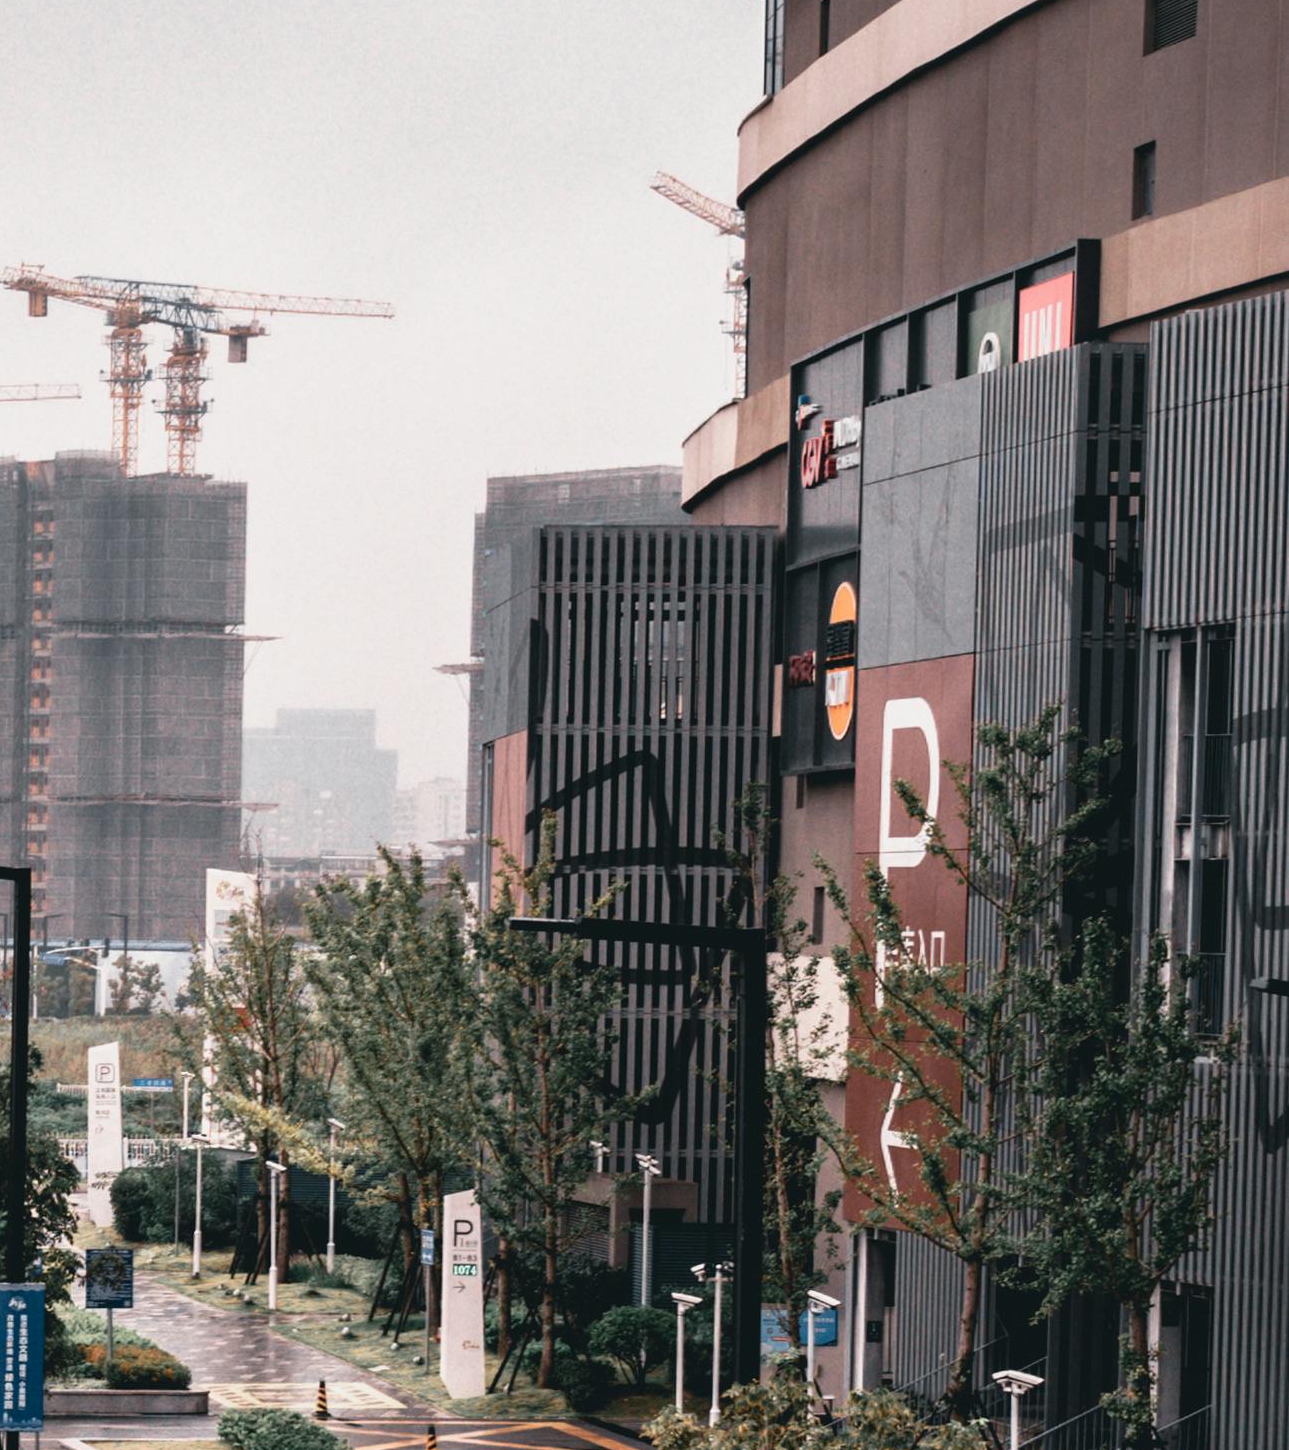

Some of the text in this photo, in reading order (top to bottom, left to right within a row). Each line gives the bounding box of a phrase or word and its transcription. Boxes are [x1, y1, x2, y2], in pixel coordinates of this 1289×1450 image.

[801, 437, 822, 488] CGV
[875, 697, 940, 1009] P
[453, 1219, 474, 1247] P
[453, 1265, 477, 1275] 1074
